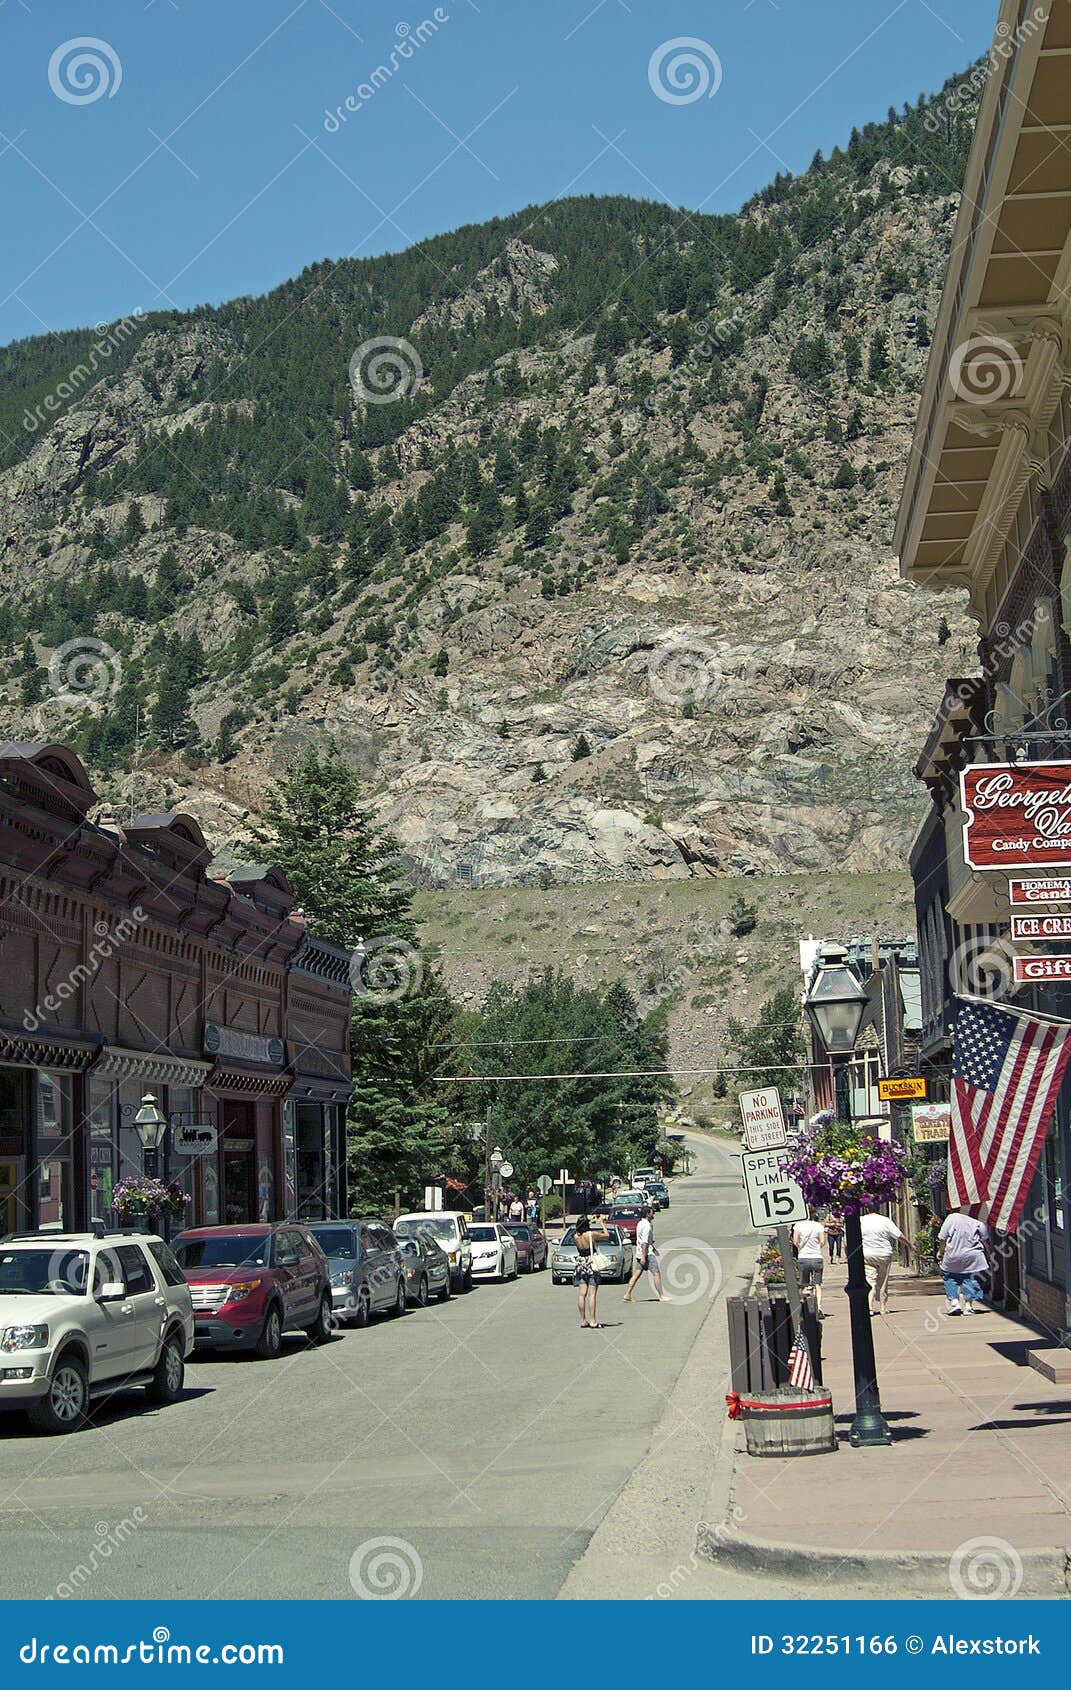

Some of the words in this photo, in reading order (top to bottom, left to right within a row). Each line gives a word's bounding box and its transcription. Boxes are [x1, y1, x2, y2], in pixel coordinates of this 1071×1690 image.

[991, 838, 1031, 852] Candy
[1016, 919, 1039, 935] ICE
[752, 1095, 767, 1108] NO
[745, 1106, 779, 1122] PARKING
[749, 1124, 762, 1134] THIS
[767, 1121, 780, 1131] SIDE
[750, 1135, 758, 1144] OF
[761, 1131, 783, 1142] STREET
[760, 1188, 794, 1218] 15
